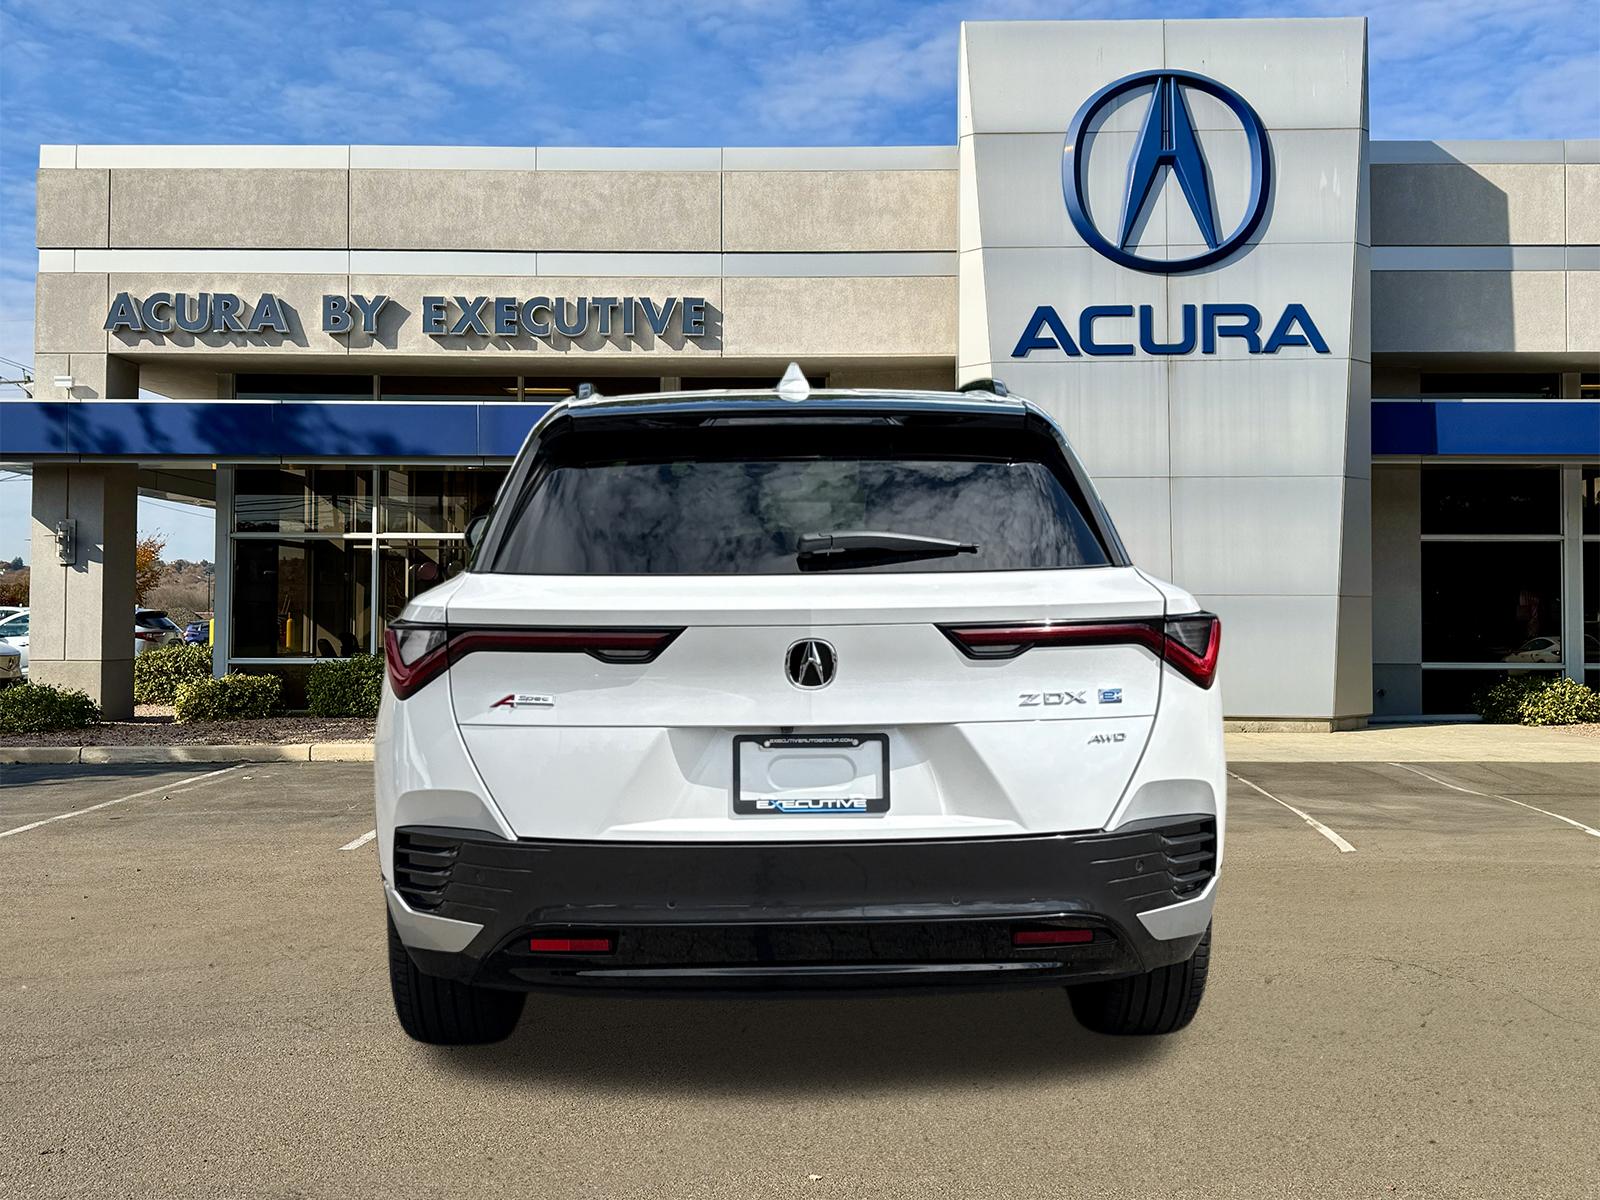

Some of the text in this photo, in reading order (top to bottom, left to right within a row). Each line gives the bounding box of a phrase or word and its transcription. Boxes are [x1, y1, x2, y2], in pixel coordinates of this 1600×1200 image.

[103, 291, 706, 337] ACURA BY EXECUTIVE
[1010, 304, 1332, 357] ACURA
[1018, 690, 1087, 707] ZDX
[1087, 732, 1126, 745] AWD
[755, 799, 867, 811] EXECUTIVE
